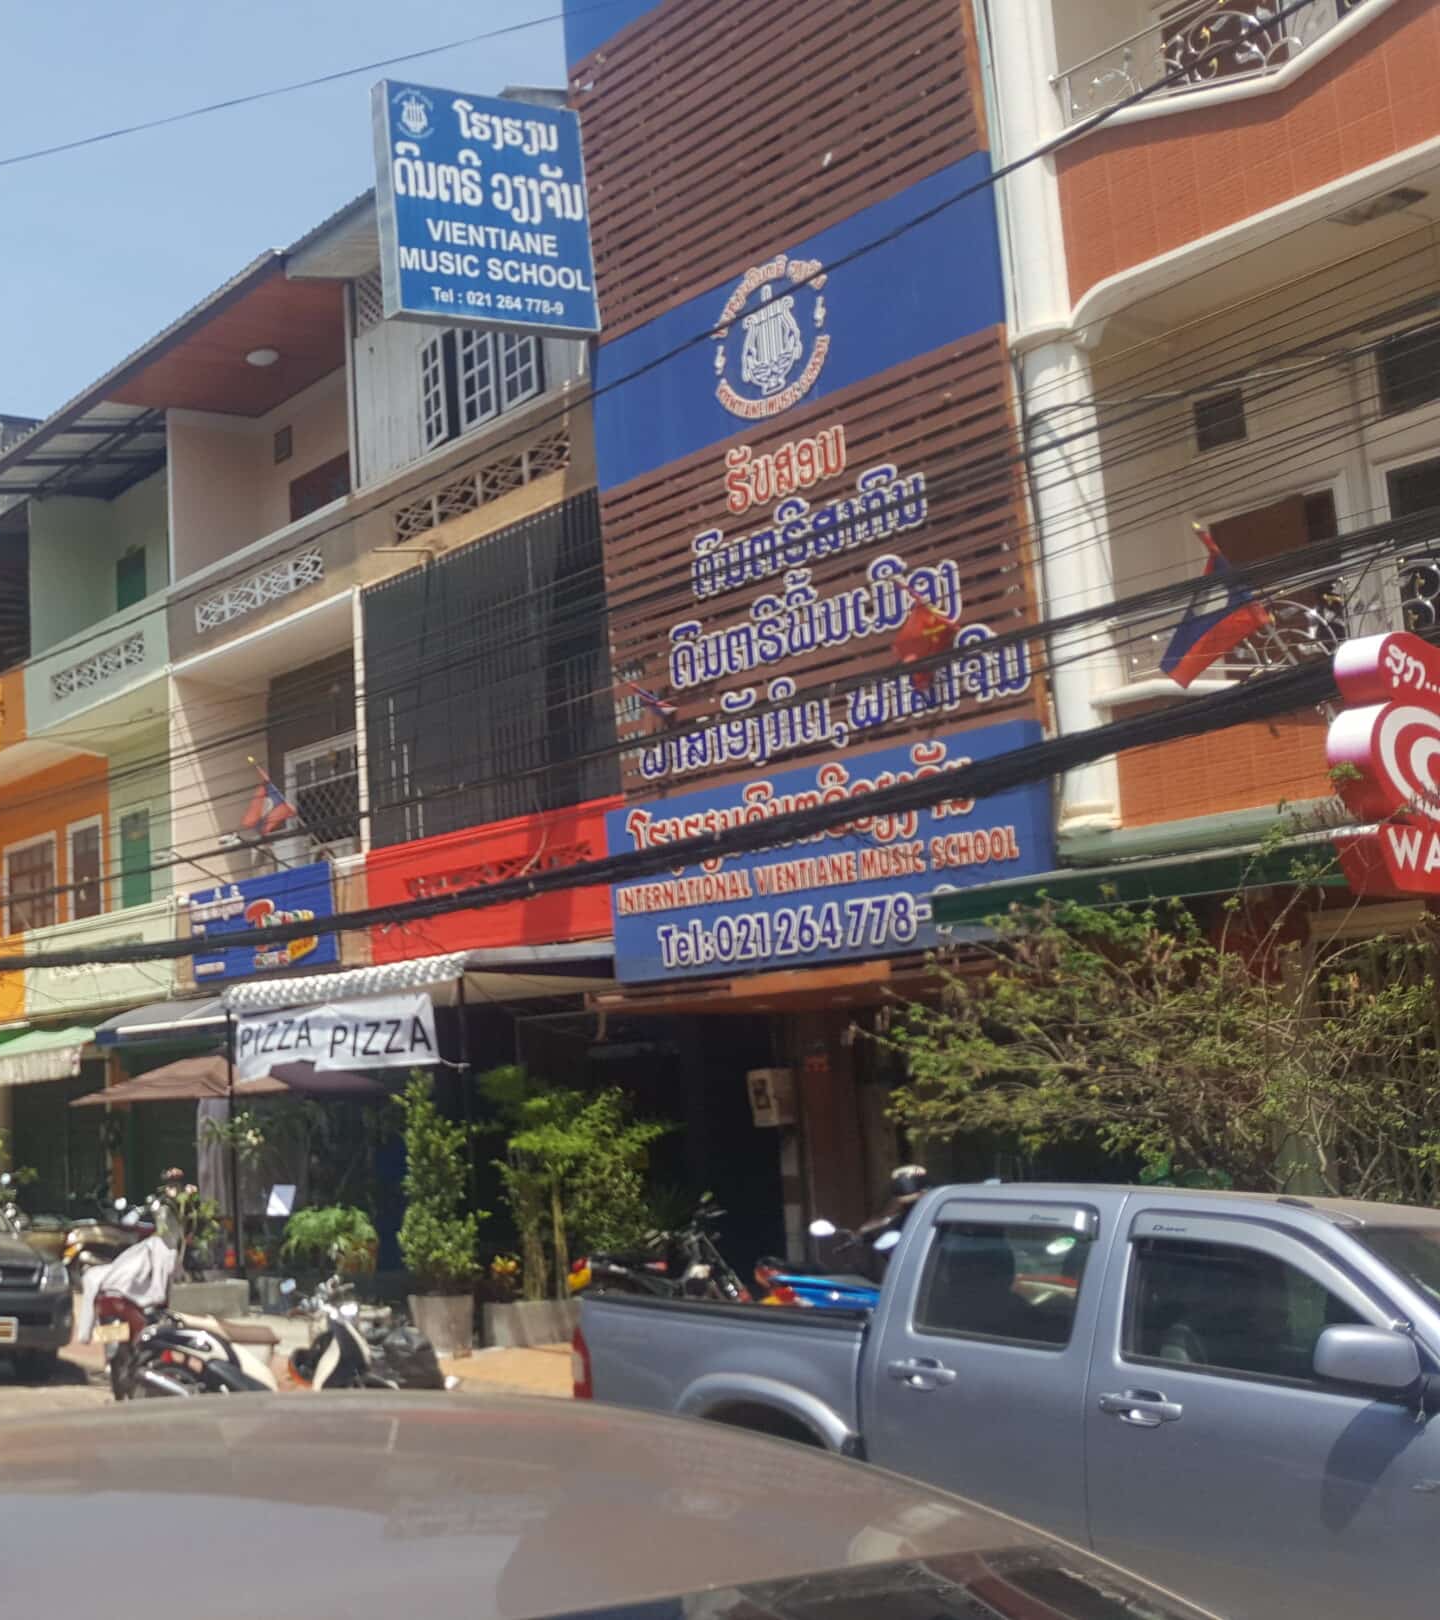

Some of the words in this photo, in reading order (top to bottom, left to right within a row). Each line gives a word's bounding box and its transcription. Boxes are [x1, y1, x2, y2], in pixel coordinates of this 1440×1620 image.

[490, 163, 584, 225] ວຽງຈັນ
[426, 217, 559, 258] VIENTIANE
[399, 246, 481, 278] MUSIC
[486, 257, 592, 292] SCHOOL
[466, 290, 493, 308] 021
[616, 869, 753, 917] INTERNATIONAL
[753, 851, 858, 896] VIENTIANE
[859, 839, 927, 880] MUSIC
[930, 826, 1021, 870] SCHOOL
[774, 901, 842, 956] 264
[844, 884, 957, 948] 778-
[238, 1016, 312, 1058] PIZZA
[329, 1015, 433, 1059] PIZZA
